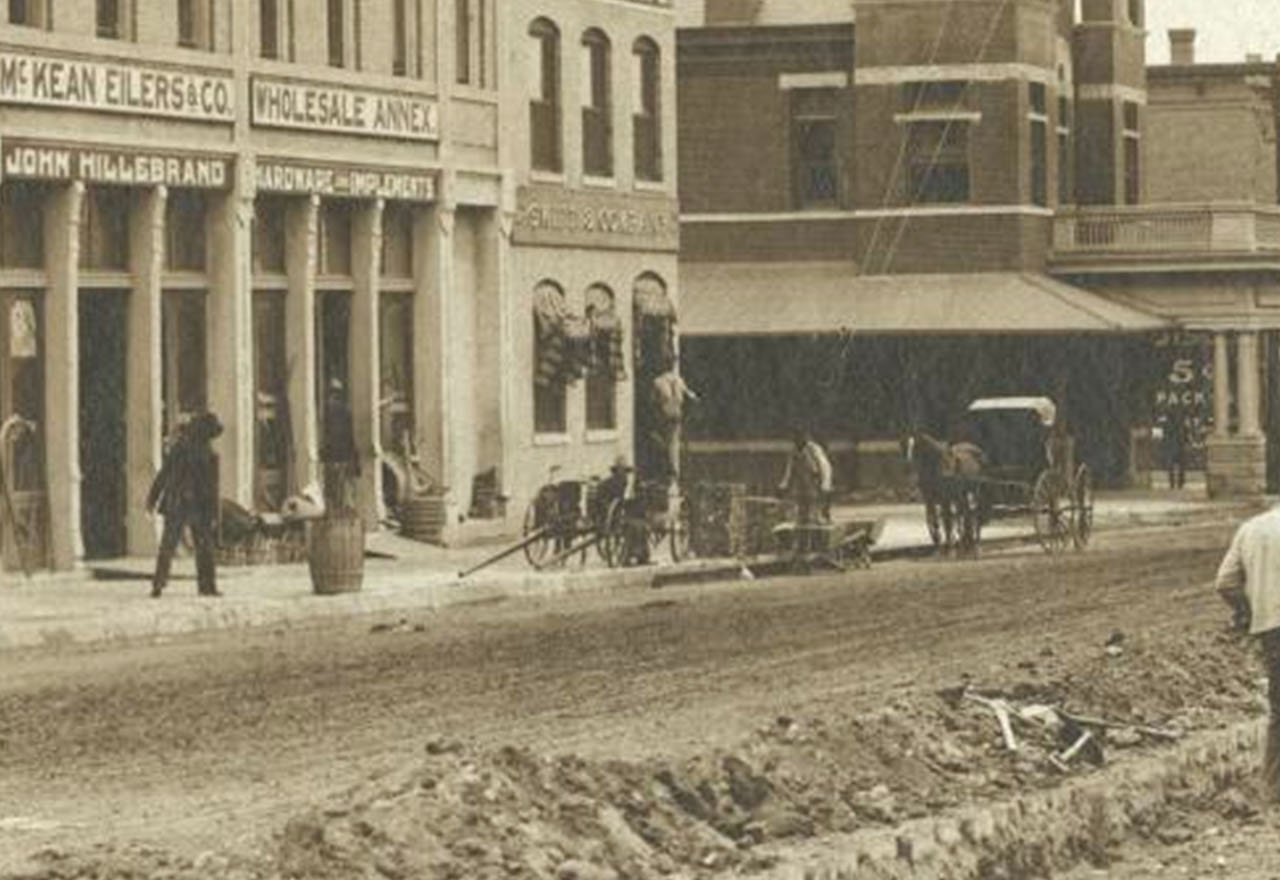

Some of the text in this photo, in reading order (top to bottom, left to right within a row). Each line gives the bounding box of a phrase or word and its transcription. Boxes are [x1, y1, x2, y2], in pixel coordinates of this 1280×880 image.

[255, 85, 365, 127] WHOLESALE
[6, 147, 70, 178] JOHN
[1169, 359, 1193, 383] 5
